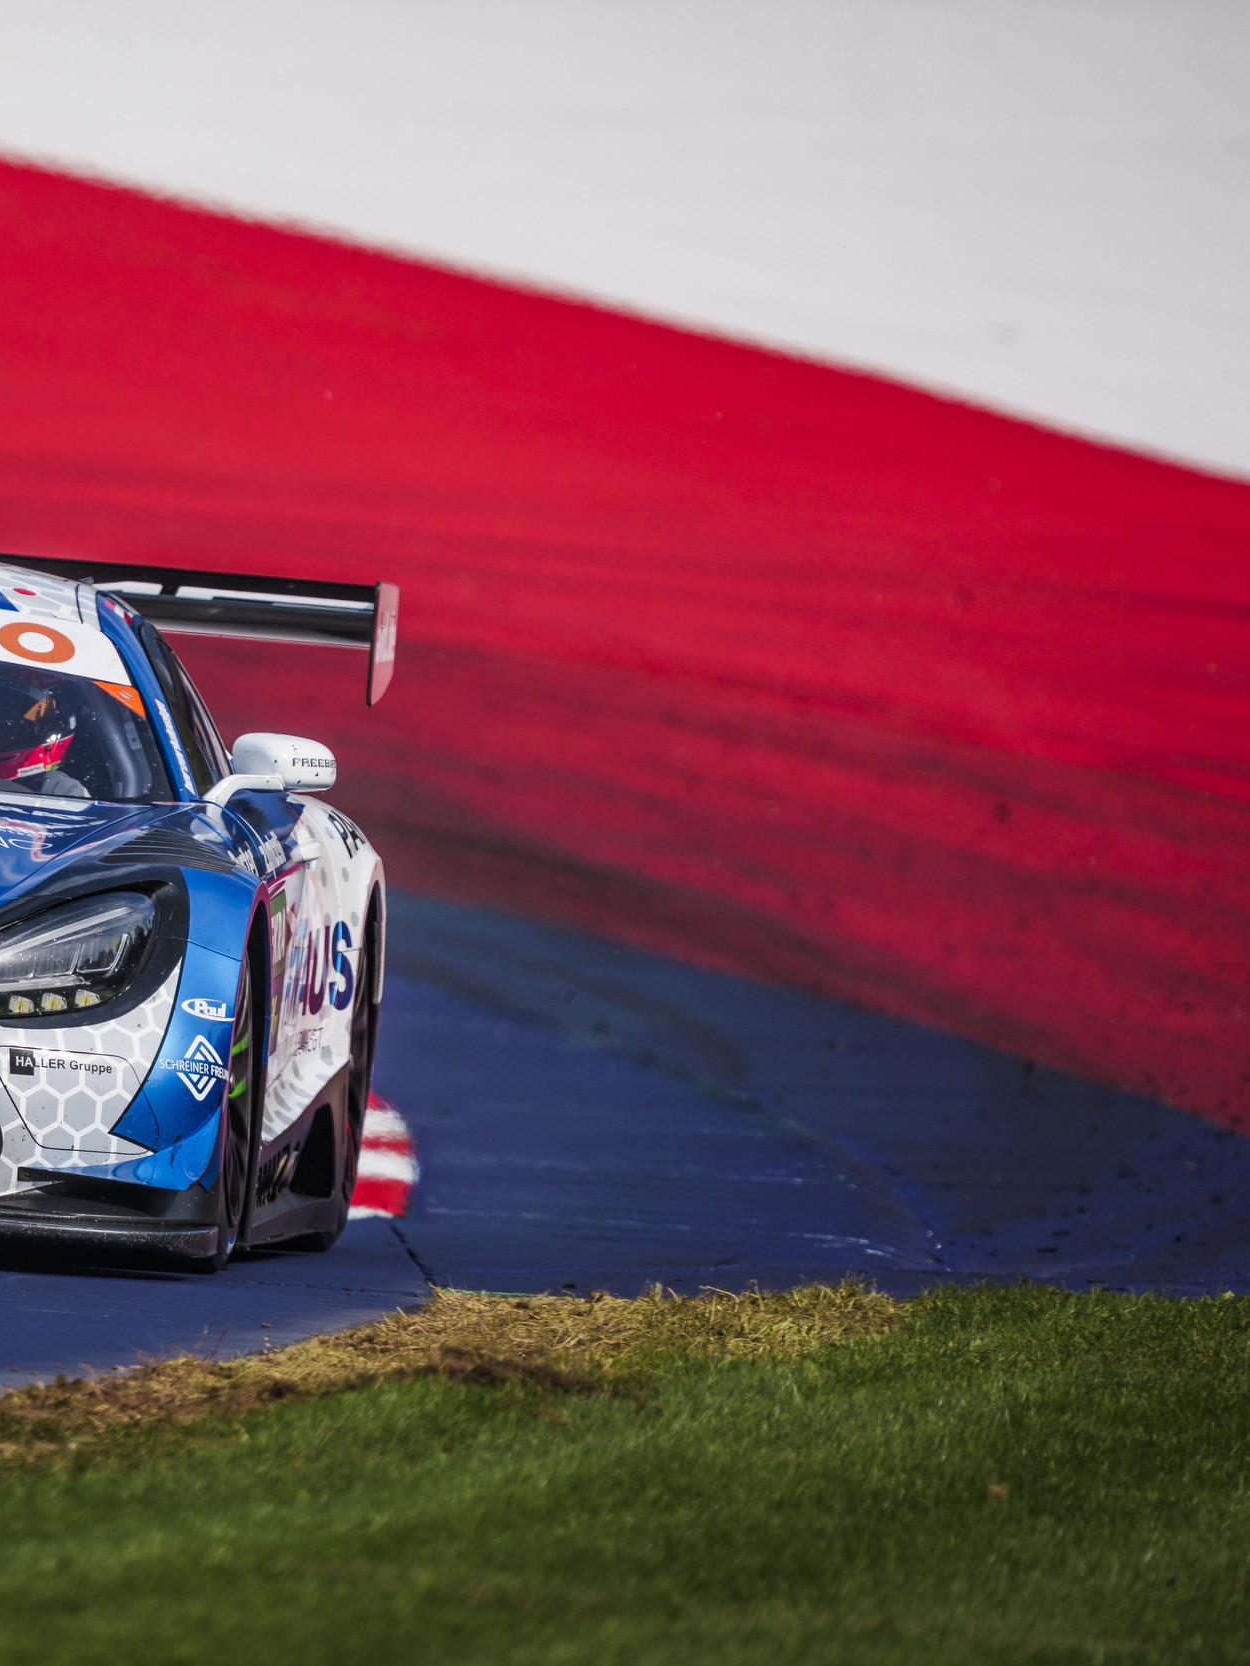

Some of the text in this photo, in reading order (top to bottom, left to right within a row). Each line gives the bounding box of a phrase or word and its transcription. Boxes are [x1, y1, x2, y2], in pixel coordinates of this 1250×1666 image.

[194, 1000, 227, 1018] Paul
[15, 1055, 113, 1075] HALLER Gruppe
[159, 1058, 210, 1075] SCHREINER
